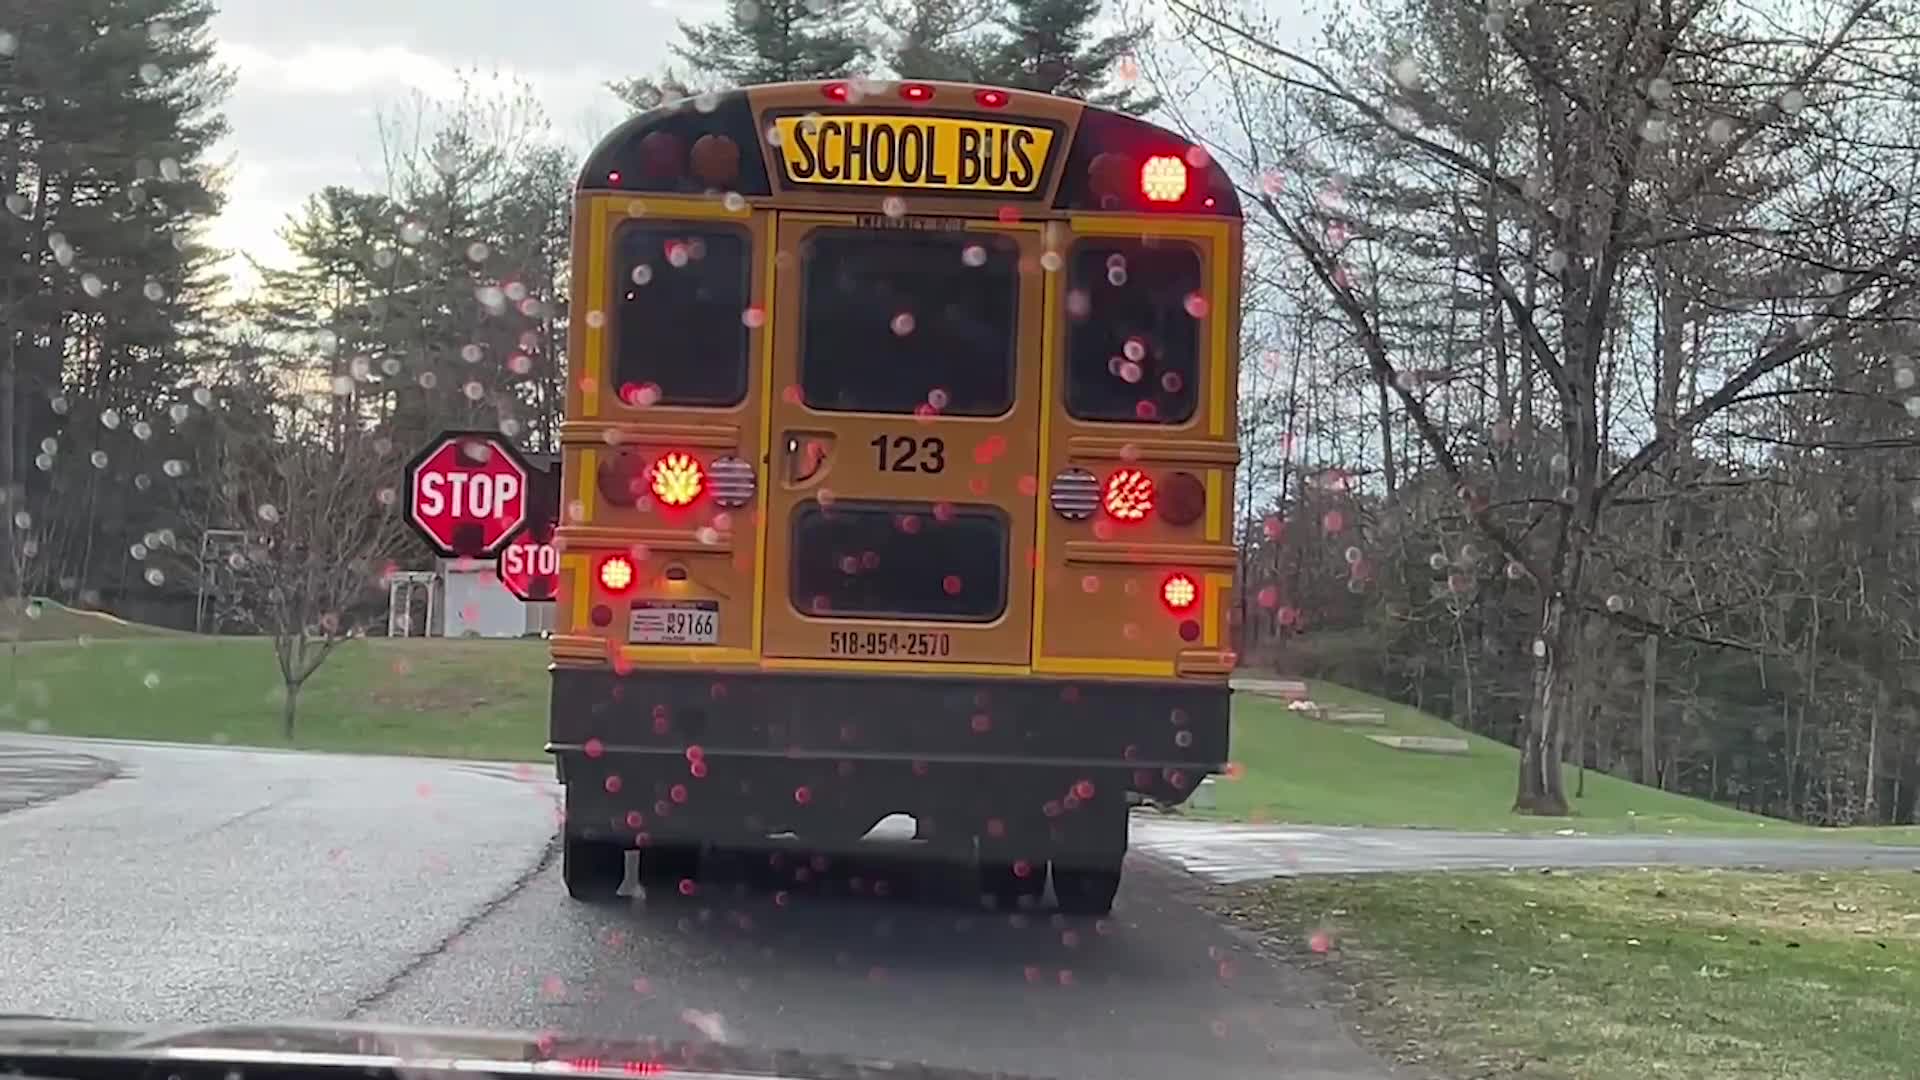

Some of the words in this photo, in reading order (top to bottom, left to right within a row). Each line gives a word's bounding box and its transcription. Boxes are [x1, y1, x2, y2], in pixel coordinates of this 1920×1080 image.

[791, 119, 948, 184] SCHOOL
[957, 126, 1036, 189] BUS
[871, 434, 945, 474] 123
[420, 471, 519, 519] STOP
[507, 544, 560, 575] STO
[830, 631, 950, 656] 518-954-2570
